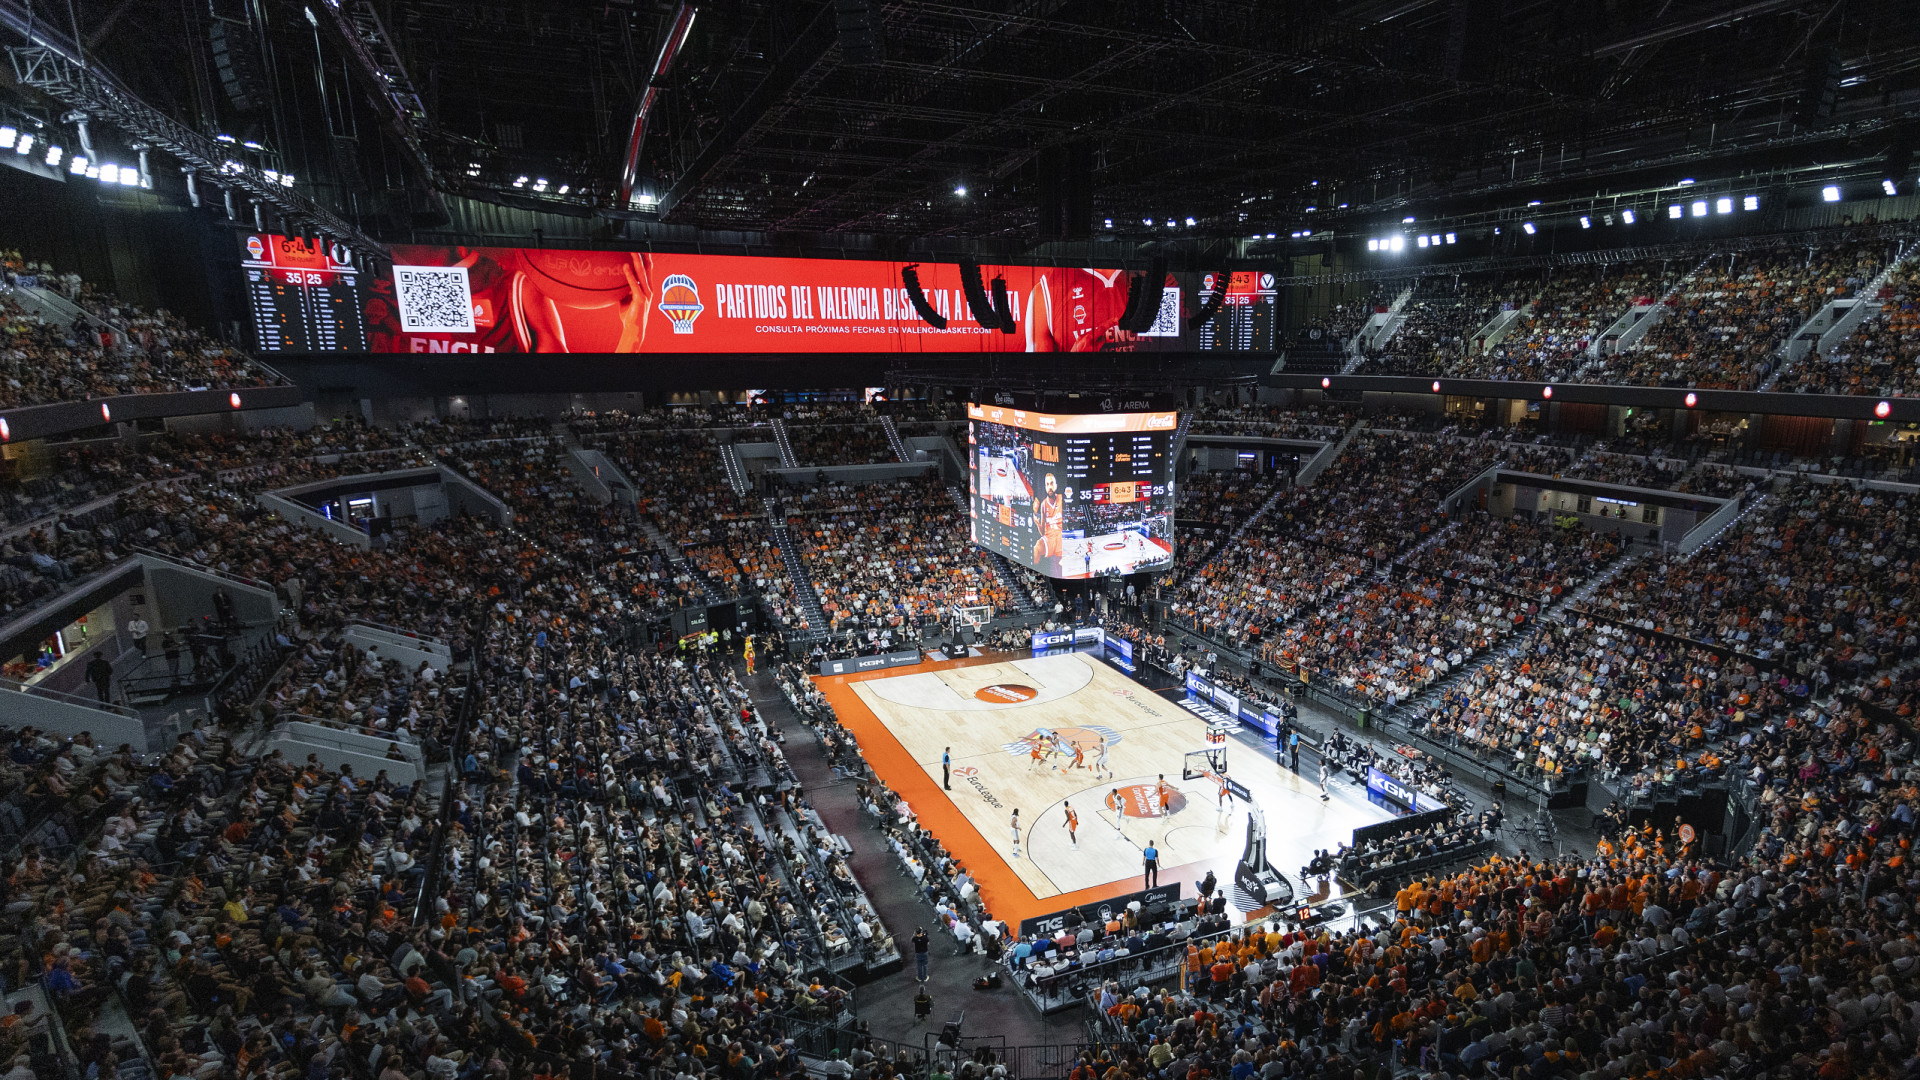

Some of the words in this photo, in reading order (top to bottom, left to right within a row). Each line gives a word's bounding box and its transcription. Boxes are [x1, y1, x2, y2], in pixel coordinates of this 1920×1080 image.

[286, 272, 302, 284] 35
[306, 273, 322, 285] 25
[716, 283, 787, 319] PARTIDOS
[791, 286, 814, 320] DEL
[817, 286, 880, 321] VALENCIA
[954, 290, 963, 321] A
[1224, 296, 1236, 304] 35
[1239, 296, 1250, 304] 25
[755, 325, 803, 333] CONSULTA
[806, 323, 850, 334] PRÓXIMAS
[852, 326, 886, 334] FECHAS
[1124, 401, 1150, 409] ARENA
[1080, 490, 1092, 500] 35
[1114, 486, 1131, 494] 6:43
[1153, 486, 1164, 495] 25
[1035, 634, 1073, 646] KGM
[859, 659, 885, 667] KGM
[1188, 677, 1213, 697] KGM
[1215, 735, 1224, 743] 12
[966, 775, 1003, 809] EuroLeague
[1370, 774, 1414, 804] KGM
[1299, 908, 1310, 920] 12
[1036, 916, 1064, 932] TKE
